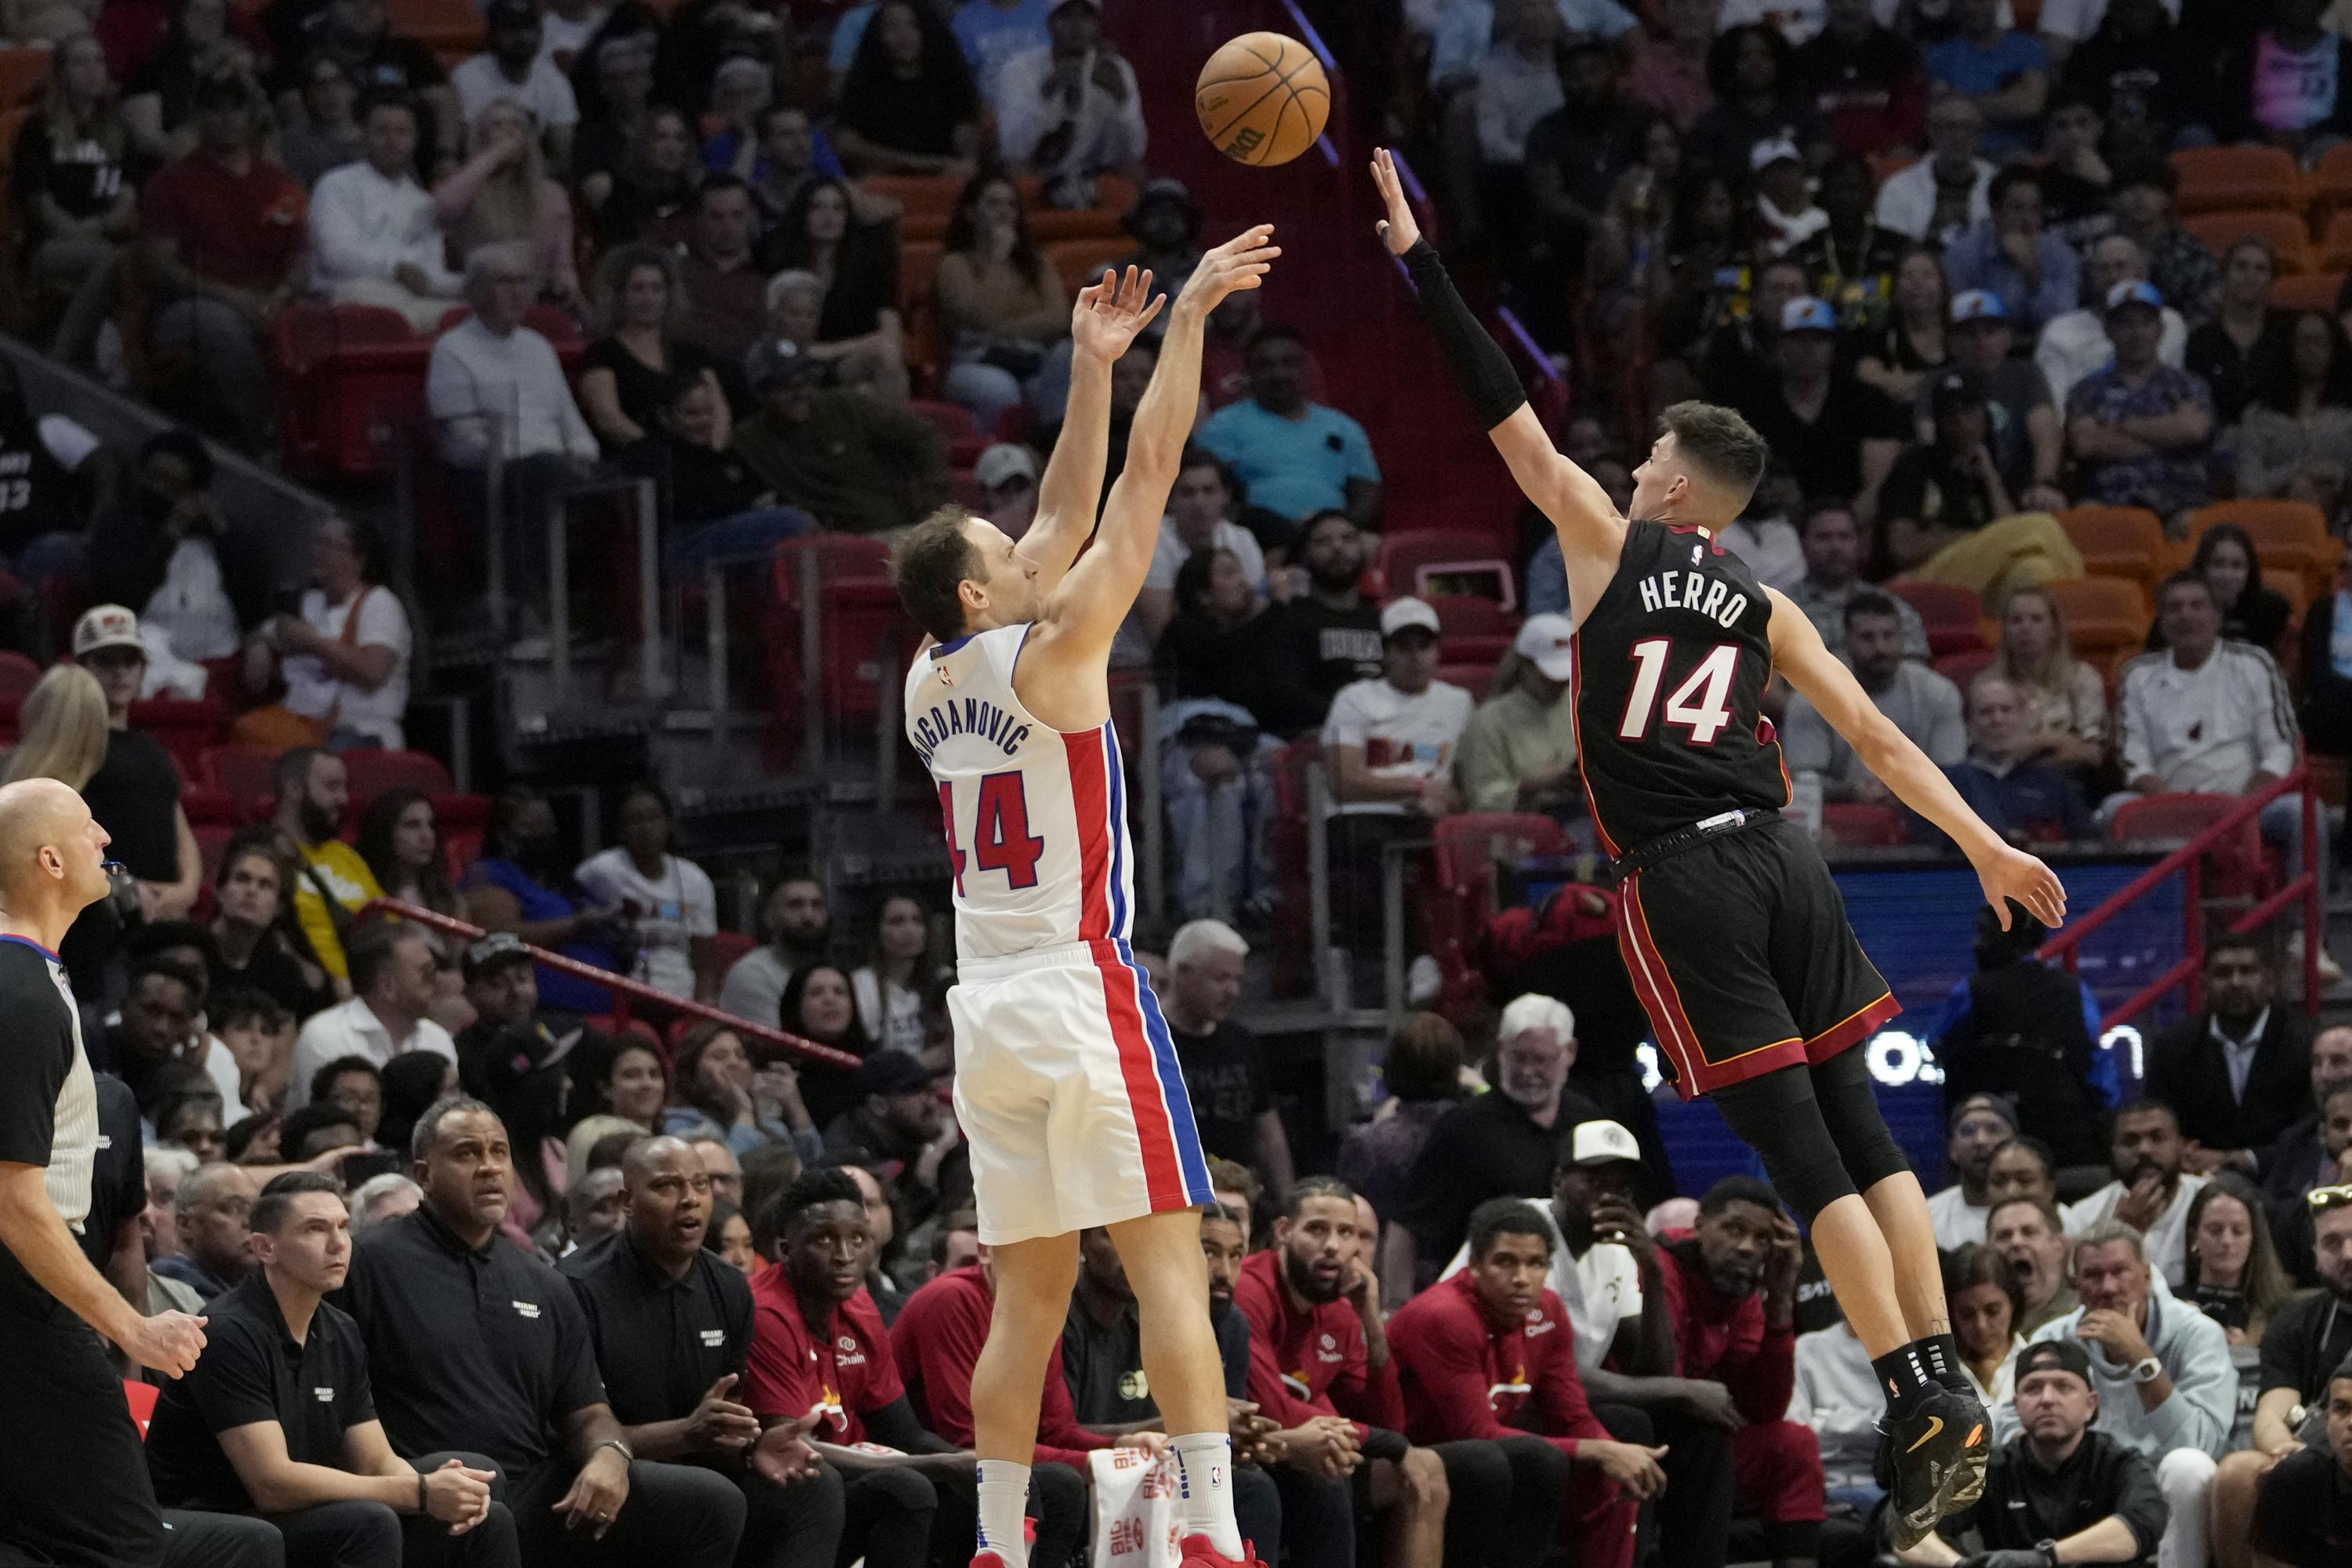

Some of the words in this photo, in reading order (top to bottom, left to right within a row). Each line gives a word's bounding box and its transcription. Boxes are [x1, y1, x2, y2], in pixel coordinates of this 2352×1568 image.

[1639, 570, 1748, 629] HERRO
[1617, 636, 1742, 747] 14
[512, 1300, 538, 1312] MIAMI
[520, 1308, 541, 1319] HEAT
[699, 1330, 724, 1339] MIAMI
[1525, 1320, 1556, 1338] Chain
